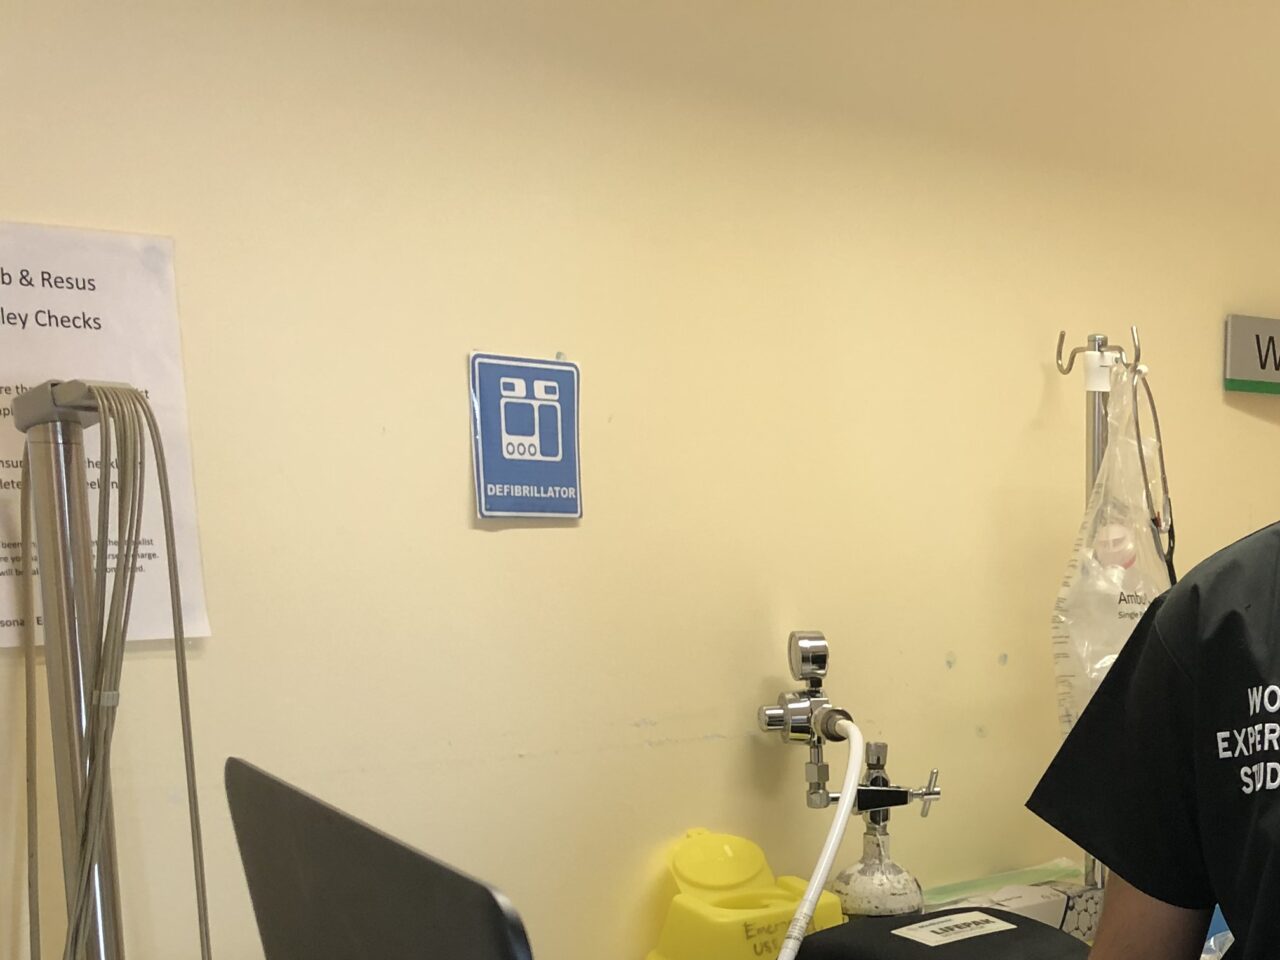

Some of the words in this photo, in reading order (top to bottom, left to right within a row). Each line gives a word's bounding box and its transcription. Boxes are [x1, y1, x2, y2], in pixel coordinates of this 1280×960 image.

[19, 269, 35, 287] &
[41, 271, 96, 291] Resus
[34, 309, 102, 331] Checks
[487, 483, 576, 499] DEFIBRILLATOR
[929, 918, 996, 935] LIFEPAK
